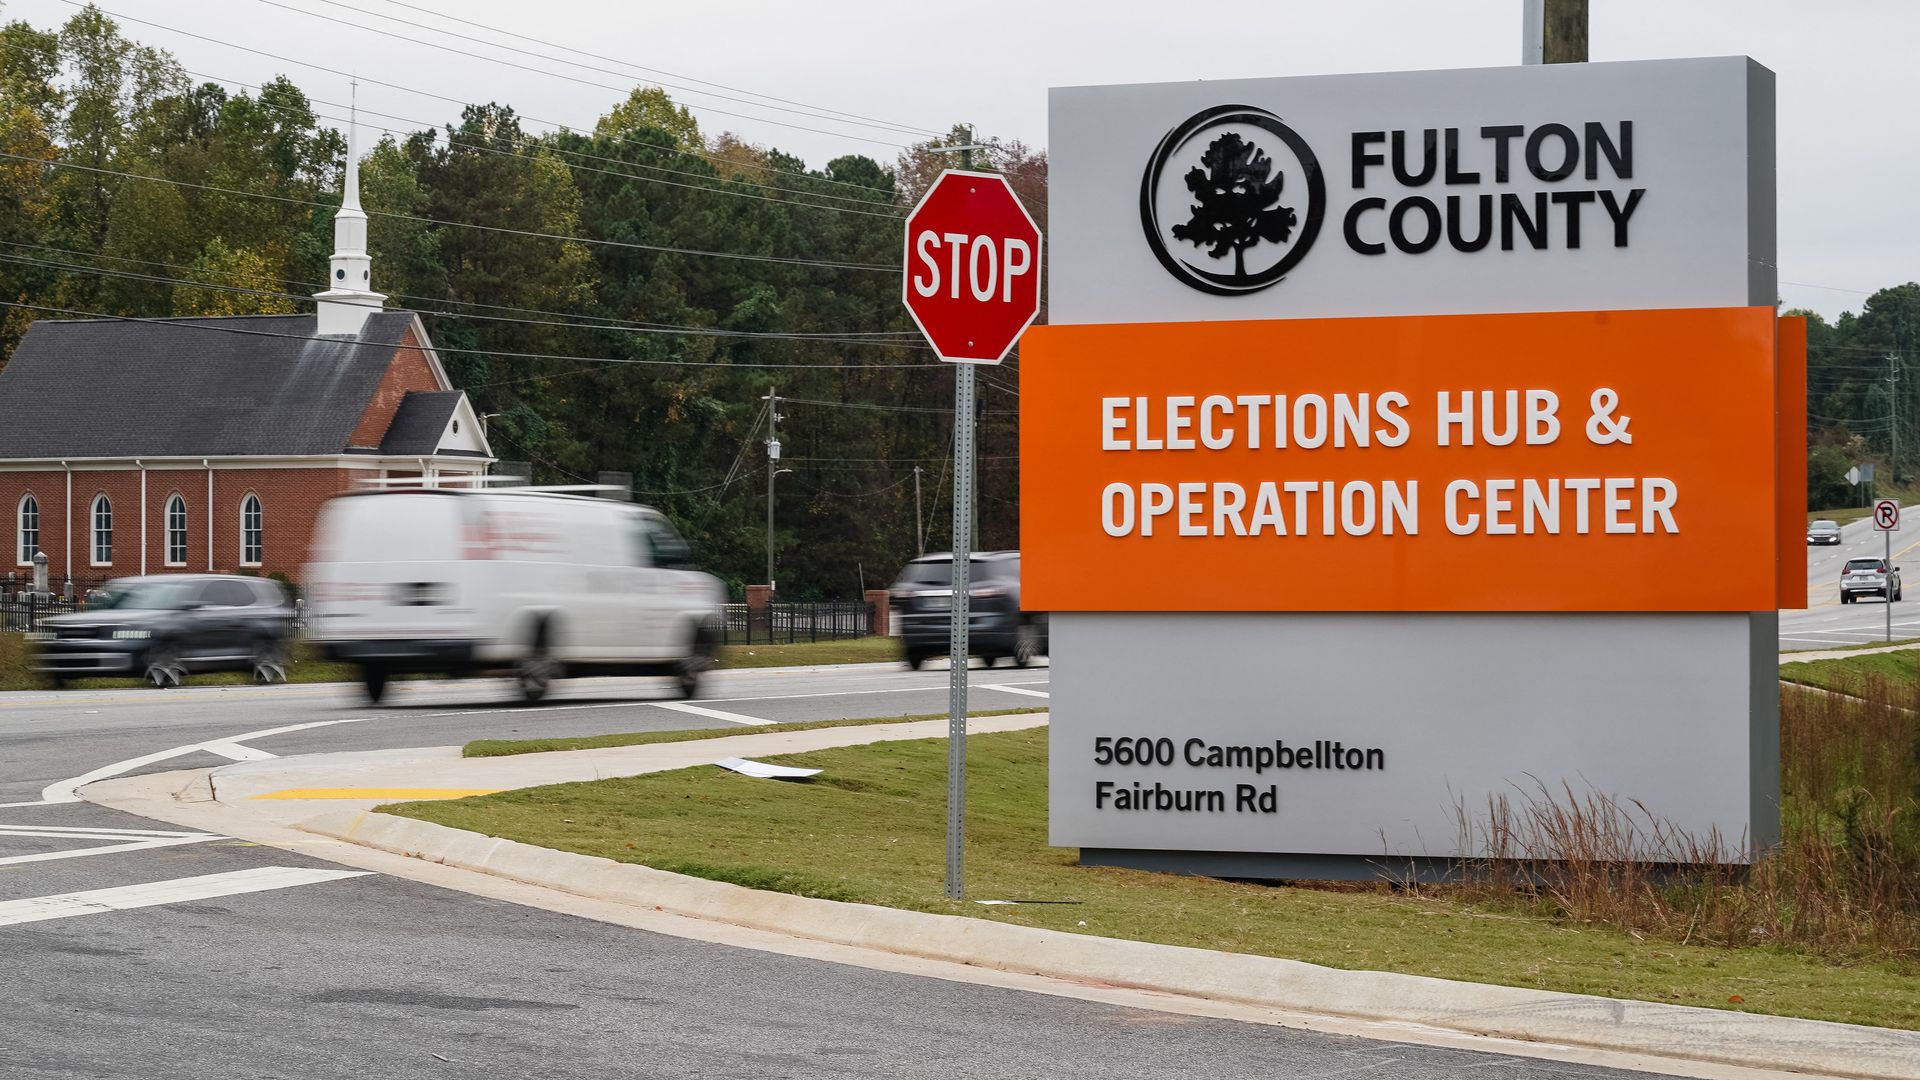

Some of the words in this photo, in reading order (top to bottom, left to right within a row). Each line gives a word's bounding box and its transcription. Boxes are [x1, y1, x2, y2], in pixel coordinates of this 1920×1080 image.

[1351, 120, 1633, 189] FULTON
[1342, 188, 1647, 257] COUNTY
[914, 229, 1032, 303] STOP
[1102, 392, 1411, 451] ELECTIONS
[1436, 389, 1562, 446] HUB
[1585, 387, 1633, 445] &
[1101, 480, 1419, 537] OPERATION
[1444, 477, 1680, 535] CENTER
[1094, 736, 1175, 767] 5600
[1183, 737, 1384, 775] Campbellton
[1096, 781, 1225, 813] Fairburn
[1235, 783, 1278, 814] Rd
